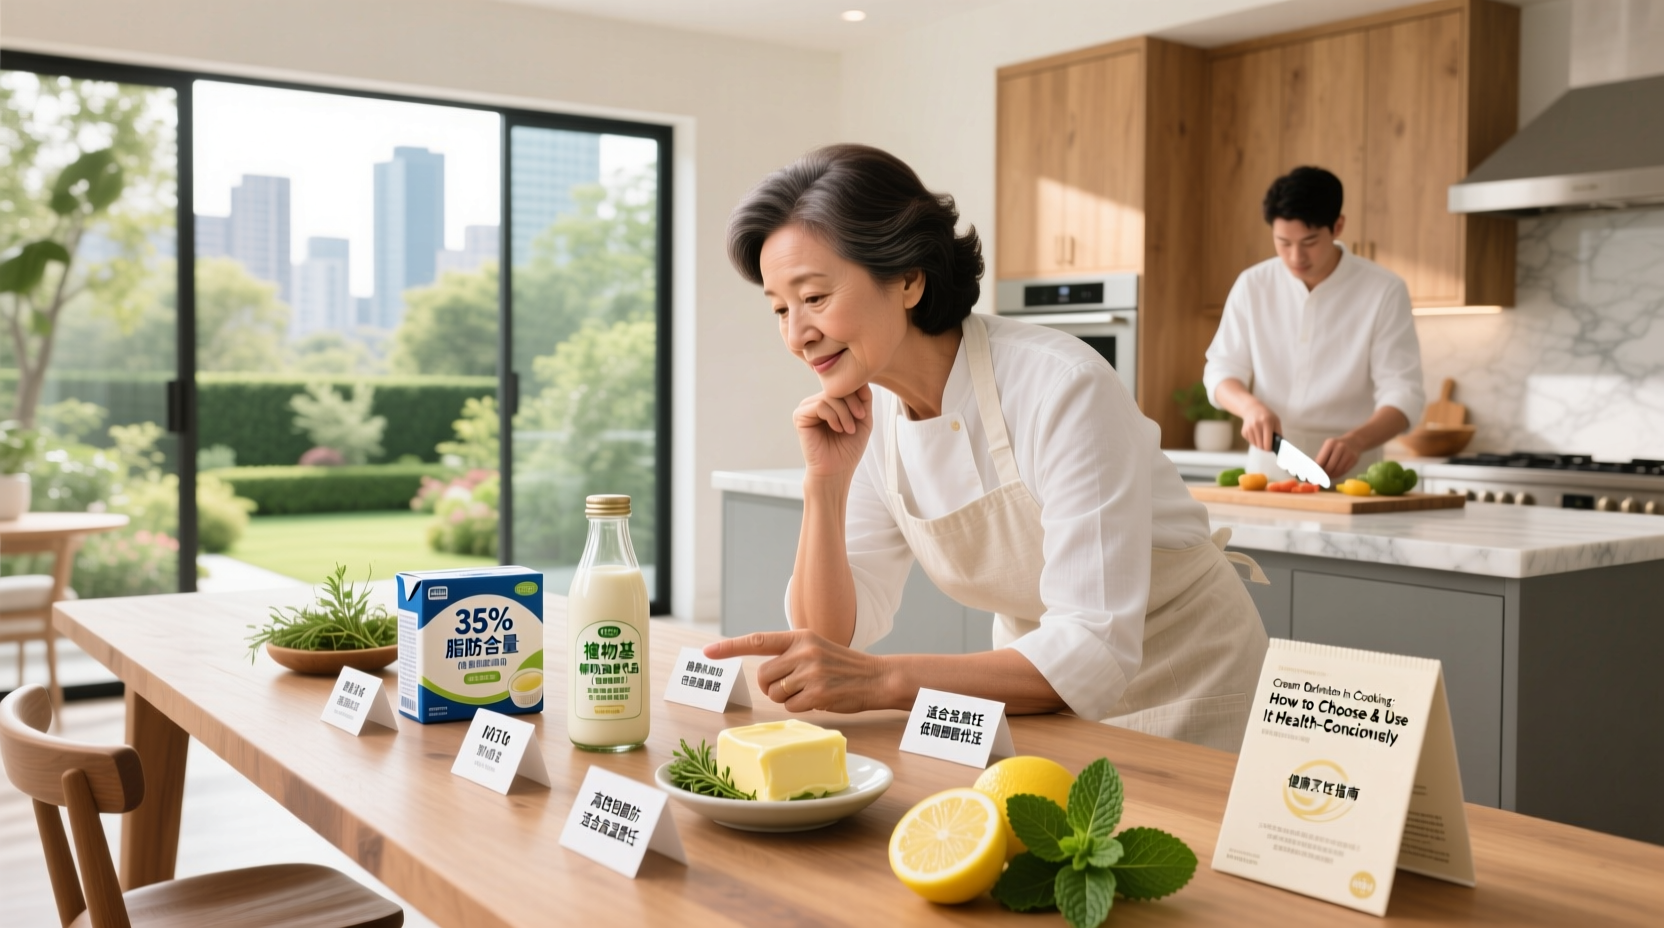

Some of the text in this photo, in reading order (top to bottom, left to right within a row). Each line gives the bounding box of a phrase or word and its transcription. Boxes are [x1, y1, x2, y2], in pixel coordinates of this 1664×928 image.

[455, 606, 513, 635] 35%
[1269, 692, 1298, 708] How
[1318, 699, 1368, 720] Choose
[1370, 708, 1379, 723] &
[1385, 710, 1409, 726] Use
